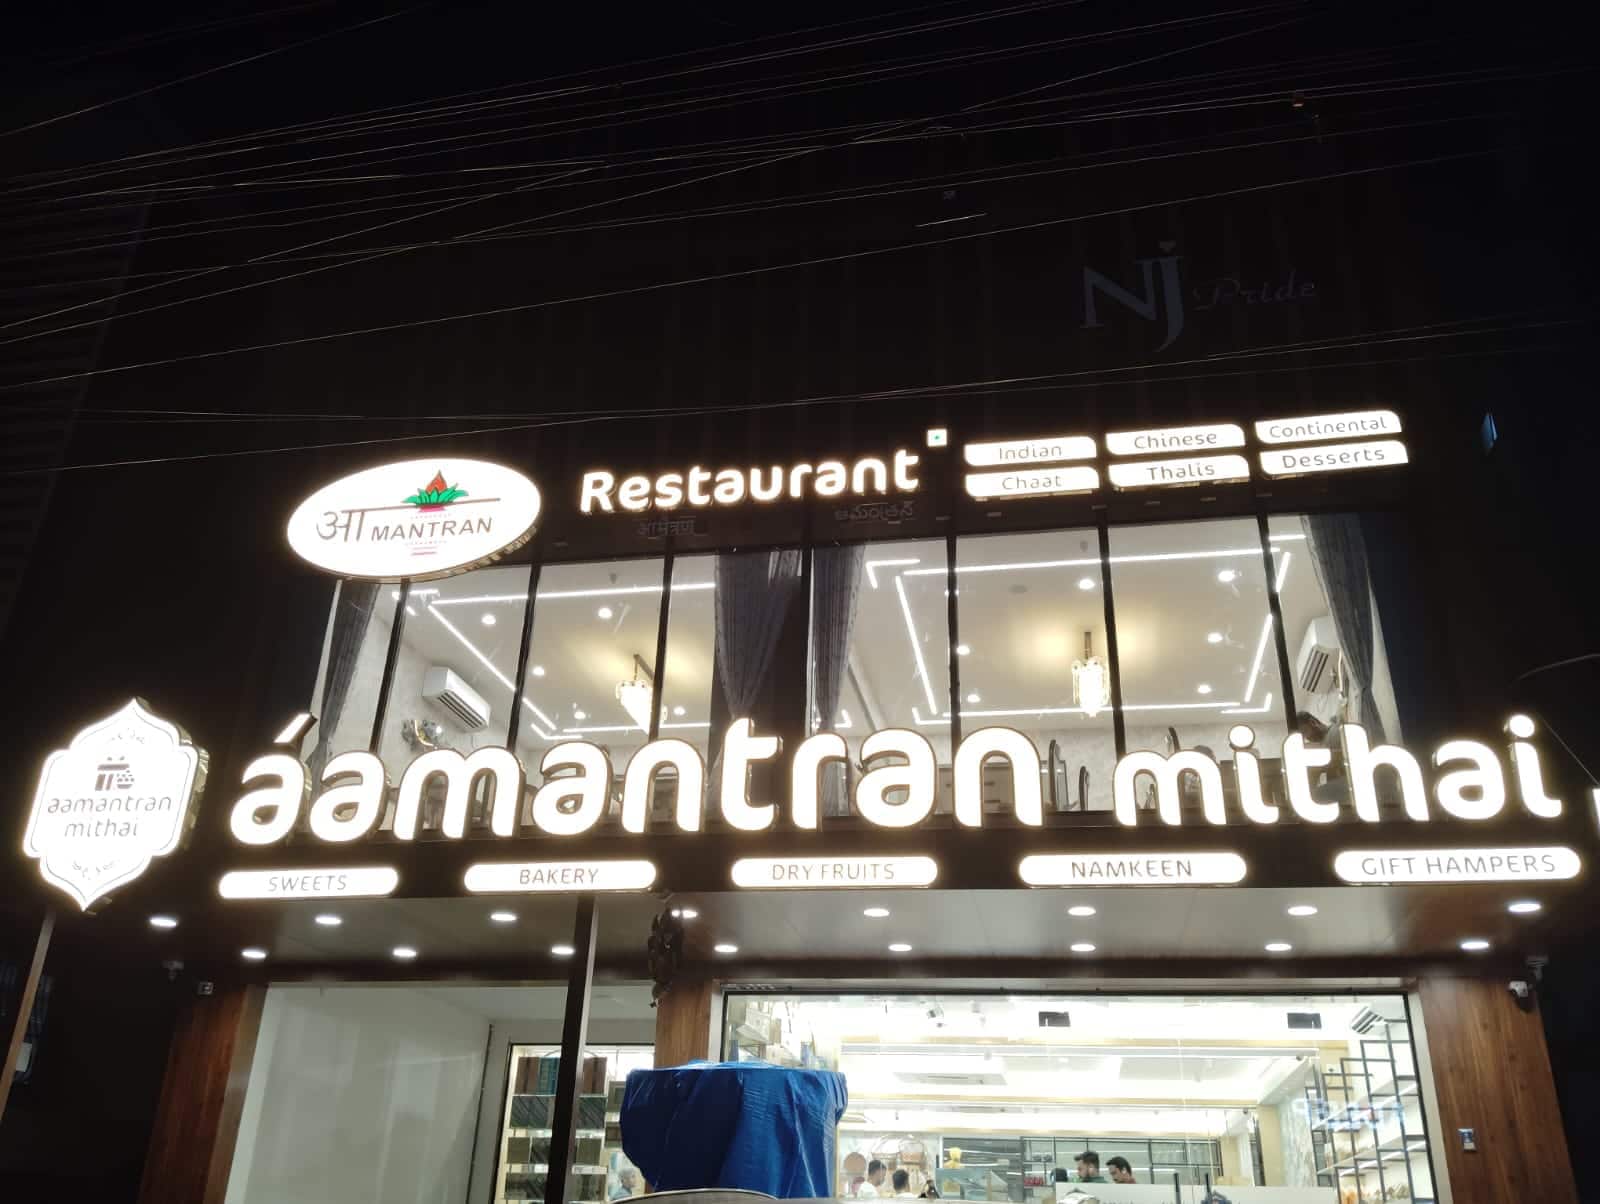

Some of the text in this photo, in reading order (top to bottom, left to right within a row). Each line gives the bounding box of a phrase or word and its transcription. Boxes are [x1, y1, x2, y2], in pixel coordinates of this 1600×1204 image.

[1268, 416, 1388, 439] Continental
[1133, 430, 1218, 450] Chinese
[998, 442, 1063, 461] Indian
[1282, 446, 1386, 469] Desserts
[1146, 461, 1216, 481] Thalis
[580, 449, 919, 514] Restaurant
[1002, 473, 1063, 491] Chaat
[1114, 714, 1563, 826] mithai
[48, 795, 173, 814] aamantran
[64, 817, 139, 838] mithai
[771, 863, 895, 882] DRY FRUITS
[1071, 859, 1193, 879] NAMKEEN
[1361, 854, 1556, 876] GIFT HAMPERS
[268, 874, 347, 892] SWEETS
[519, 867, 599, 885] BAKERY
